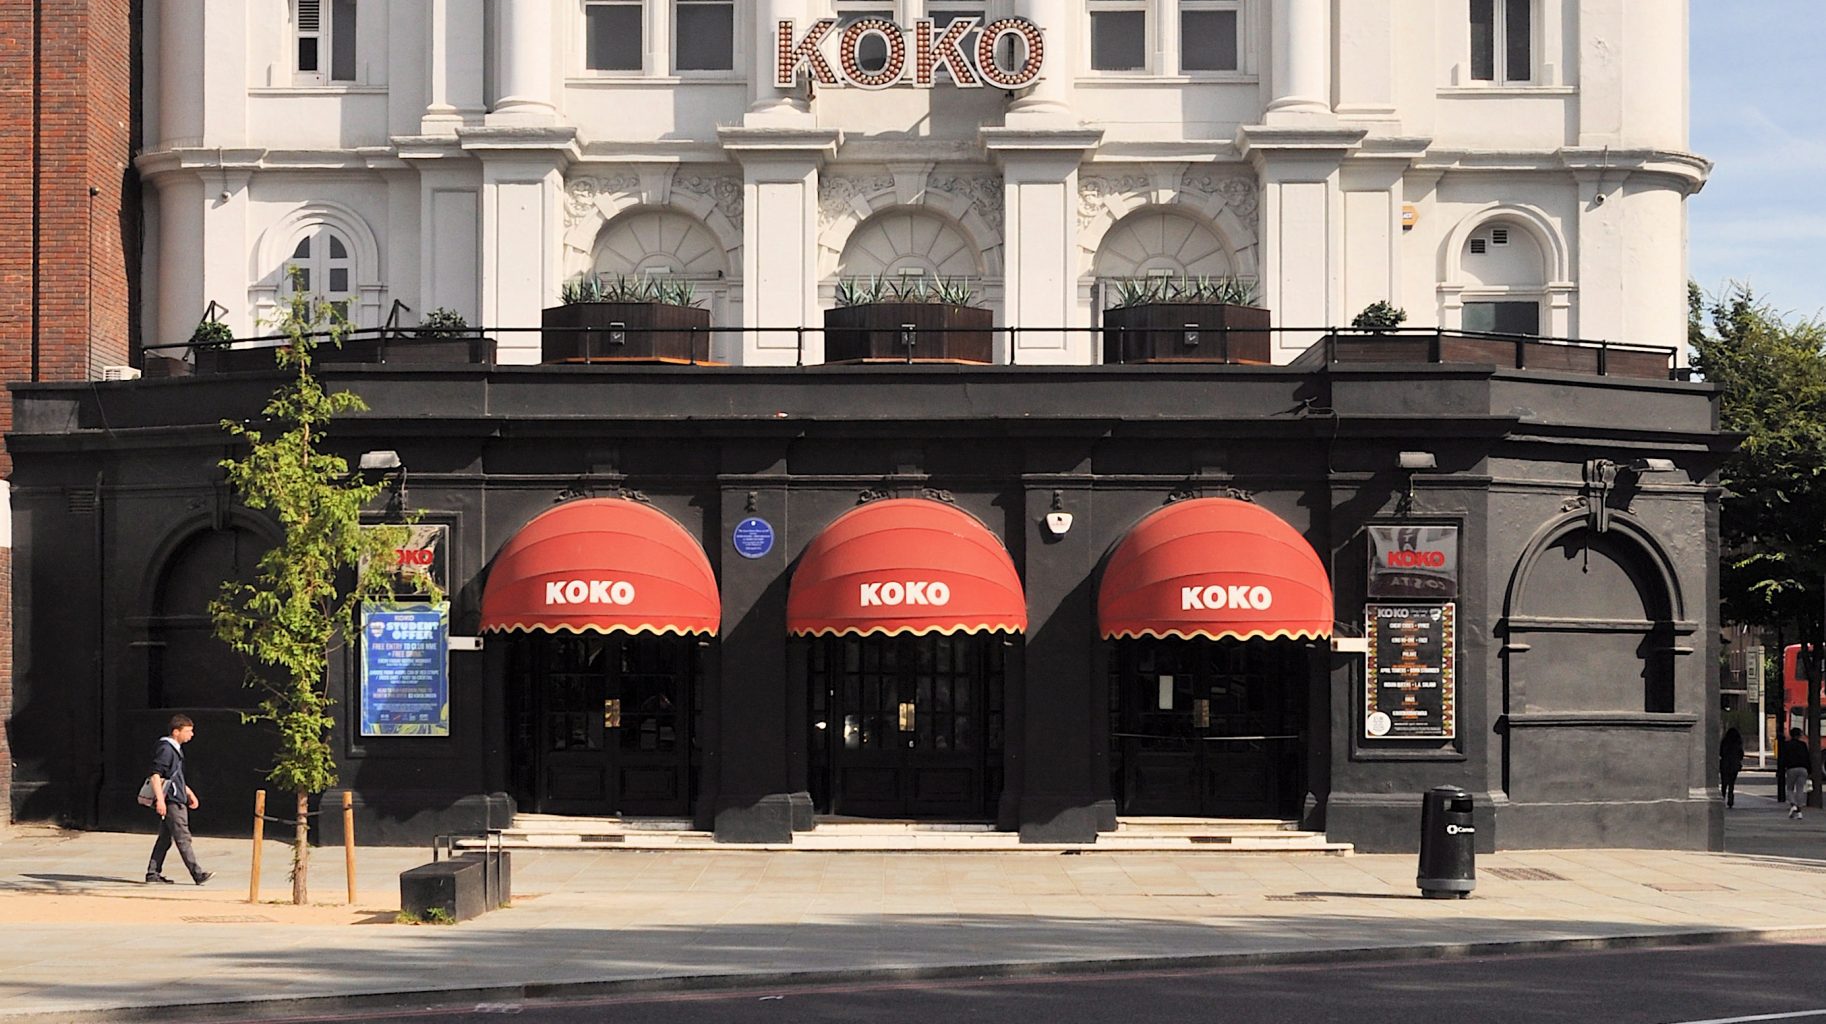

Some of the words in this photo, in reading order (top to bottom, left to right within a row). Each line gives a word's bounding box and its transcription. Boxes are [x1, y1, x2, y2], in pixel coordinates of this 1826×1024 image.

[774, 16, 1047, 90] KOKO
[393, 549, 434, 566] OKO
[1387, 551, 1445, 567] KOKO
[546, 580, 635, 605] KOKO
[861, 581, 950, 606] KOKO
[1182, 585, 1272, 610] KOKO
[1378, 608, 1409, 618] KOKO
[386, 622, 439, 631] STUDENT
[392, 631, 433, 640] OFFER
